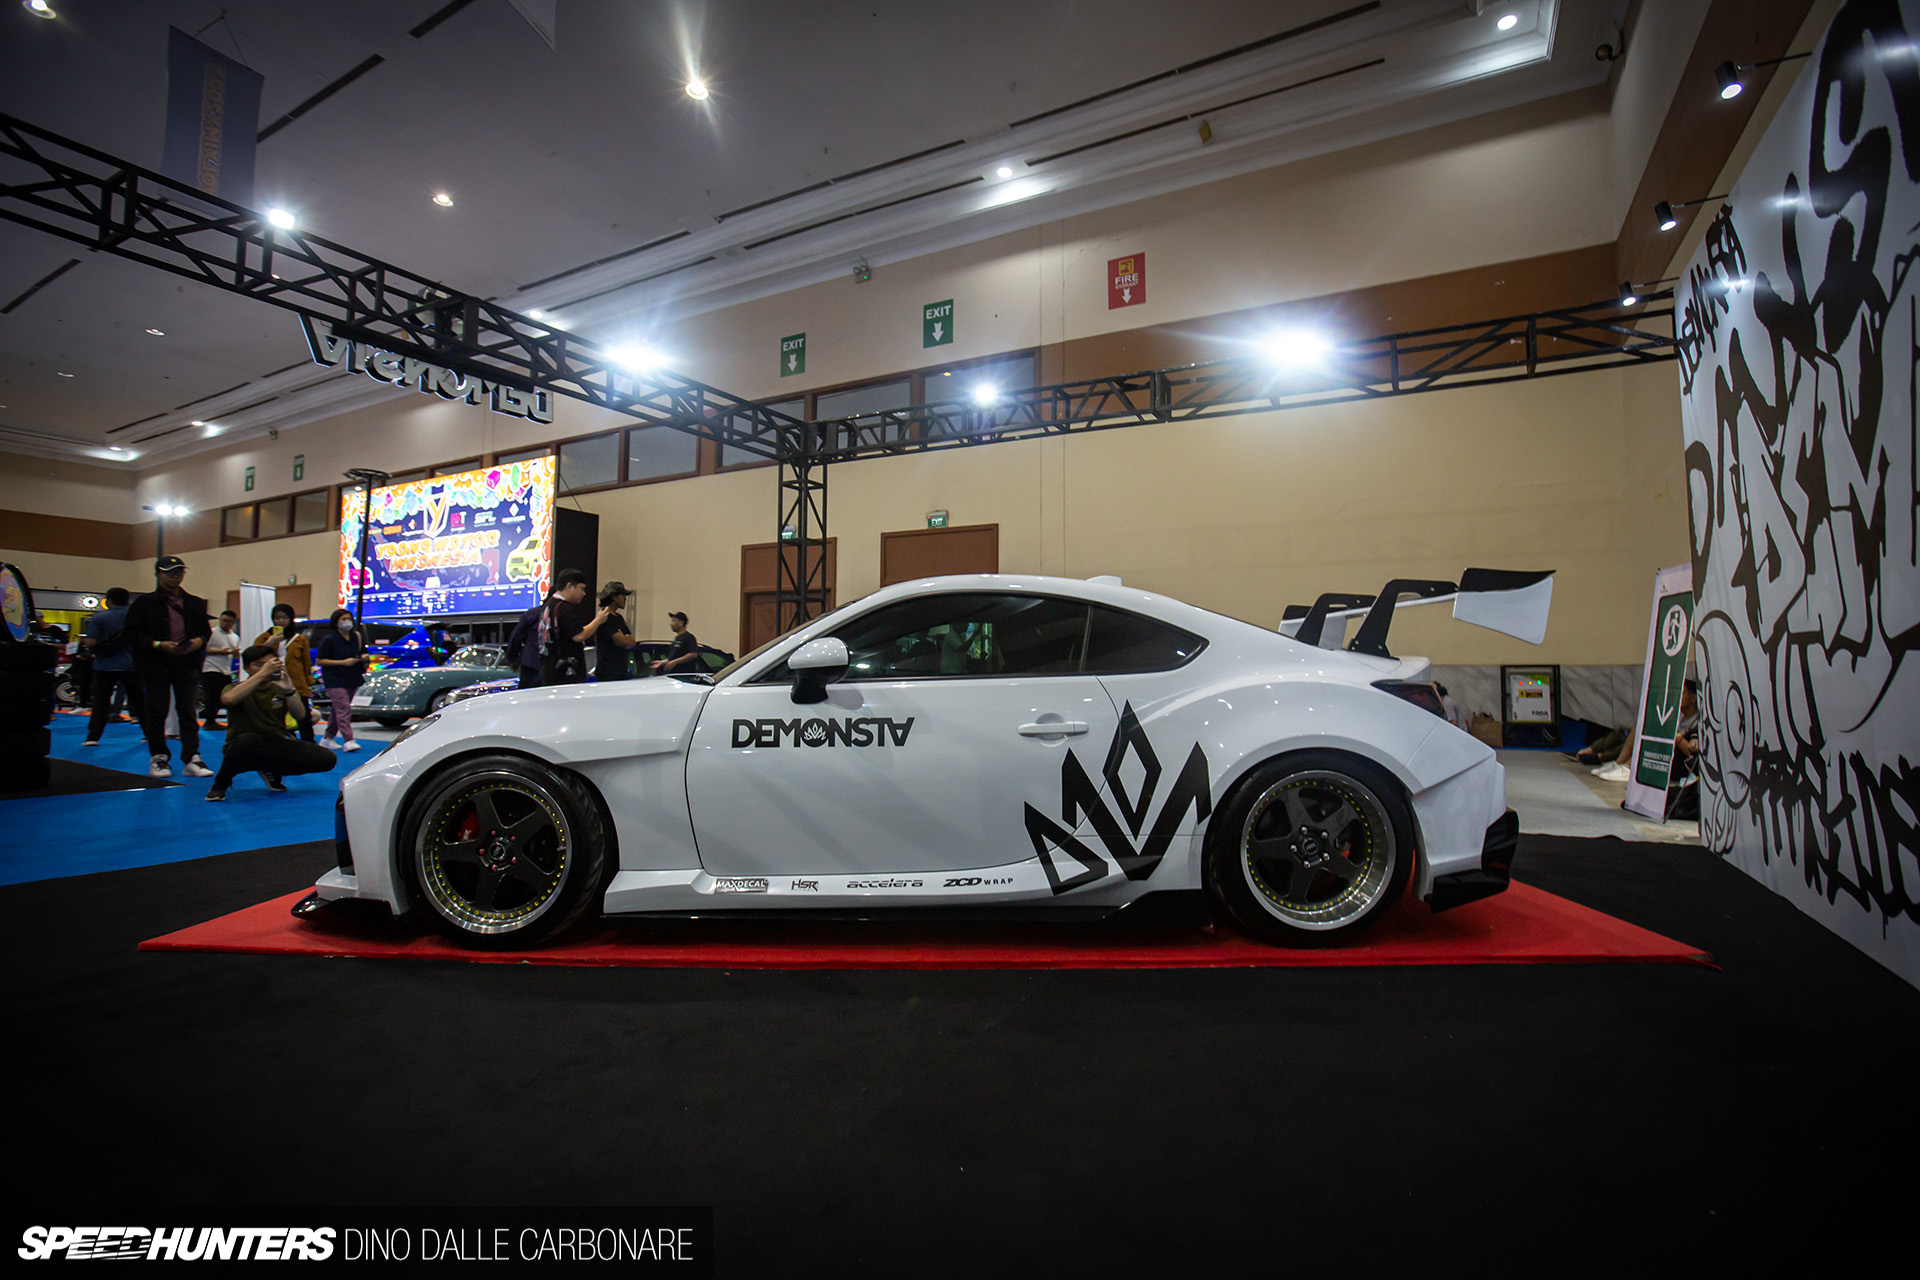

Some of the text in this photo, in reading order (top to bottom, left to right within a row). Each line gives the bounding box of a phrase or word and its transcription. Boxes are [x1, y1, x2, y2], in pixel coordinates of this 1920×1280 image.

[1115, 272, 1138, 285] FIRE
[926, 305, 951, 319] EXIT
[783, 338, 804, 351] EXIT
[931, 518, 943, 527] EXIT
[433, 529, 500, 551] MOTOR
[716, 879, 767, 891] MAXDECAL
[791, 879, 819, 891] HSR
[847, 878, 923, 889] accelera
[984, 877, 1014, 886] WRAP
